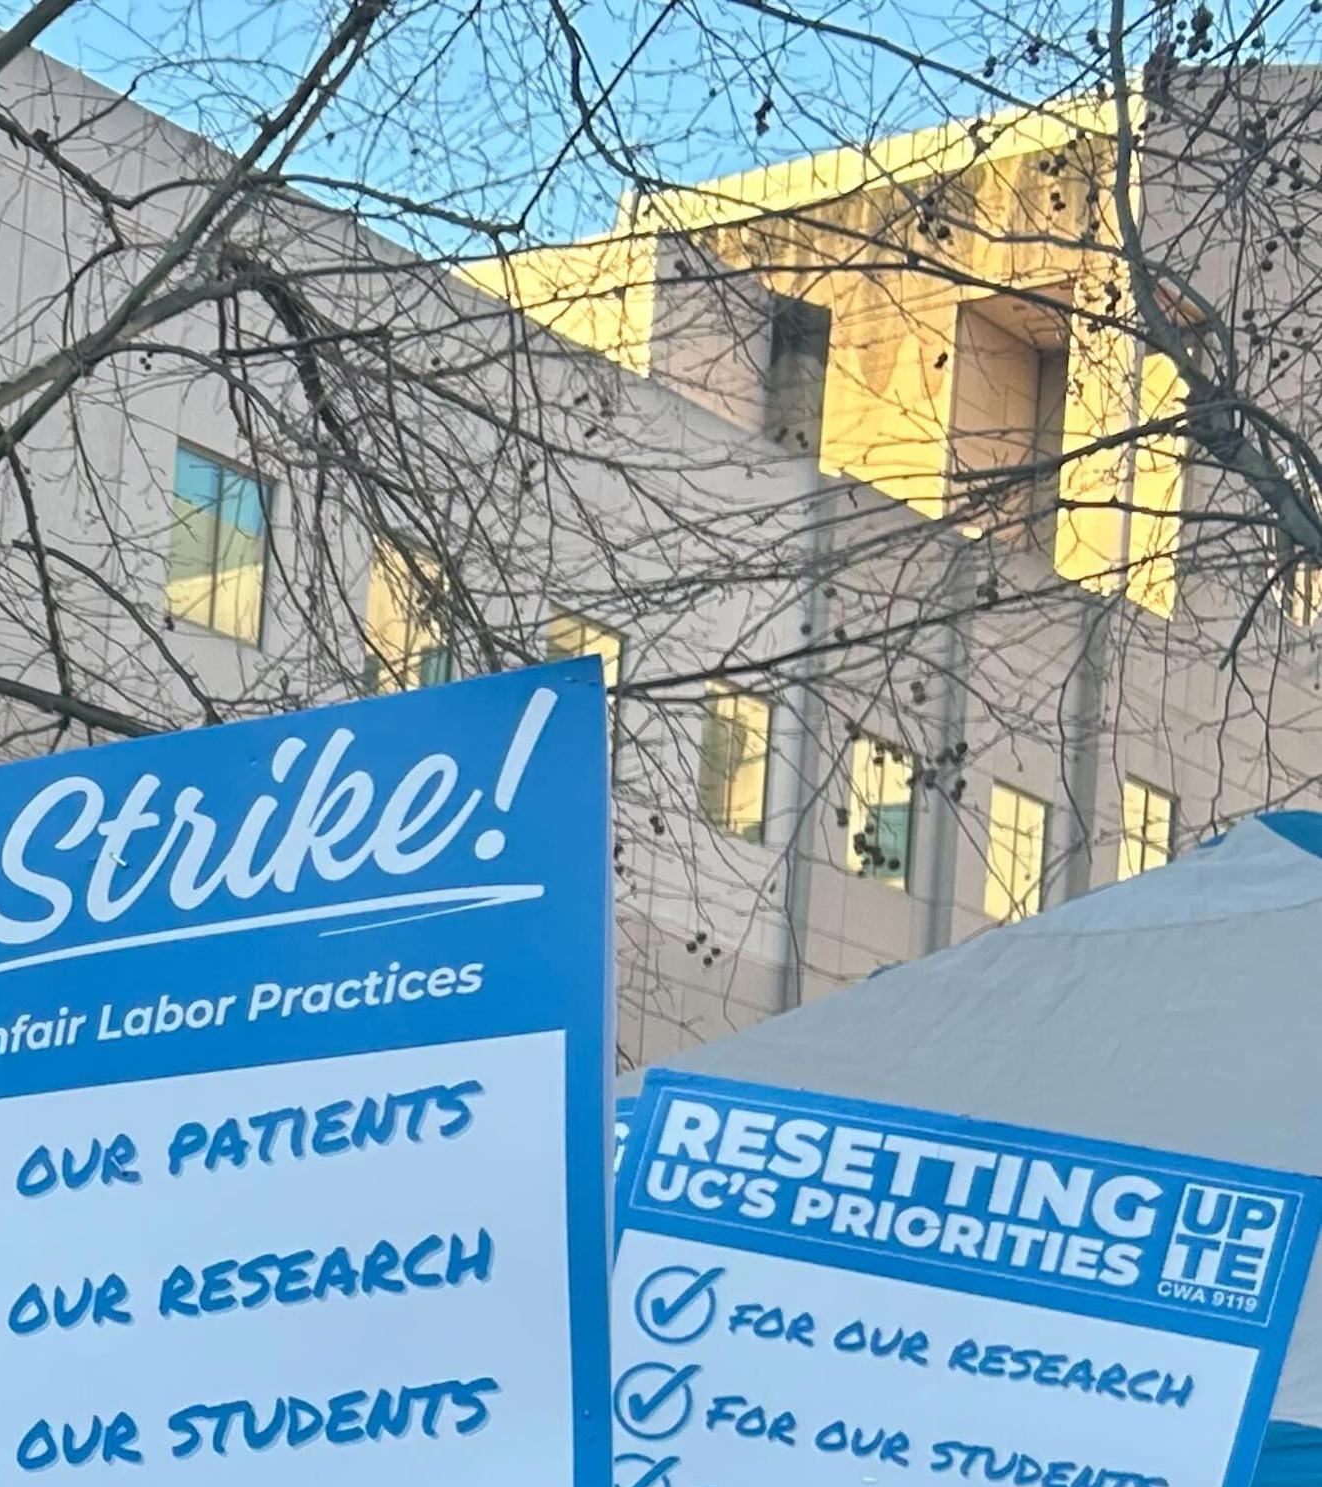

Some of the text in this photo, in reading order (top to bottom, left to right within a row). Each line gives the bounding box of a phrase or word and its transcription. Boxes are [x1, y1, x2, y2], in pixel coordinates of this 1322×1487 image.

[97, 990, 238, 1041] Labor
[247, 959, 485, 1022] Practices
[16, 1134, 138, 1198] OUR
[166, 1079, 484, 1176] PATIENTS
[656, 1100, 1163, 1240] RESETTING
[646, 1159, 1143, 1287] UC'S PRIORITIES
[1180, 1186, 1278, 1241] UP
[8, 1267, 132, 1329] OUR
[158, 1229, 493, 1317] RESEARCH
[1156, 1281, 1258, 1313] CWA 9119
[1166, 1234, 1265, 1291] TE
[727, 1304, 1194, 1408] FOR OUR RESEARCH
[17, 1406, 144, 1470] OUR
[169, 1377, 500, 1458] STUDENTS
[706, 1395, 796, 1446] FOR
[815, 1421, 910, 1466] OUR
